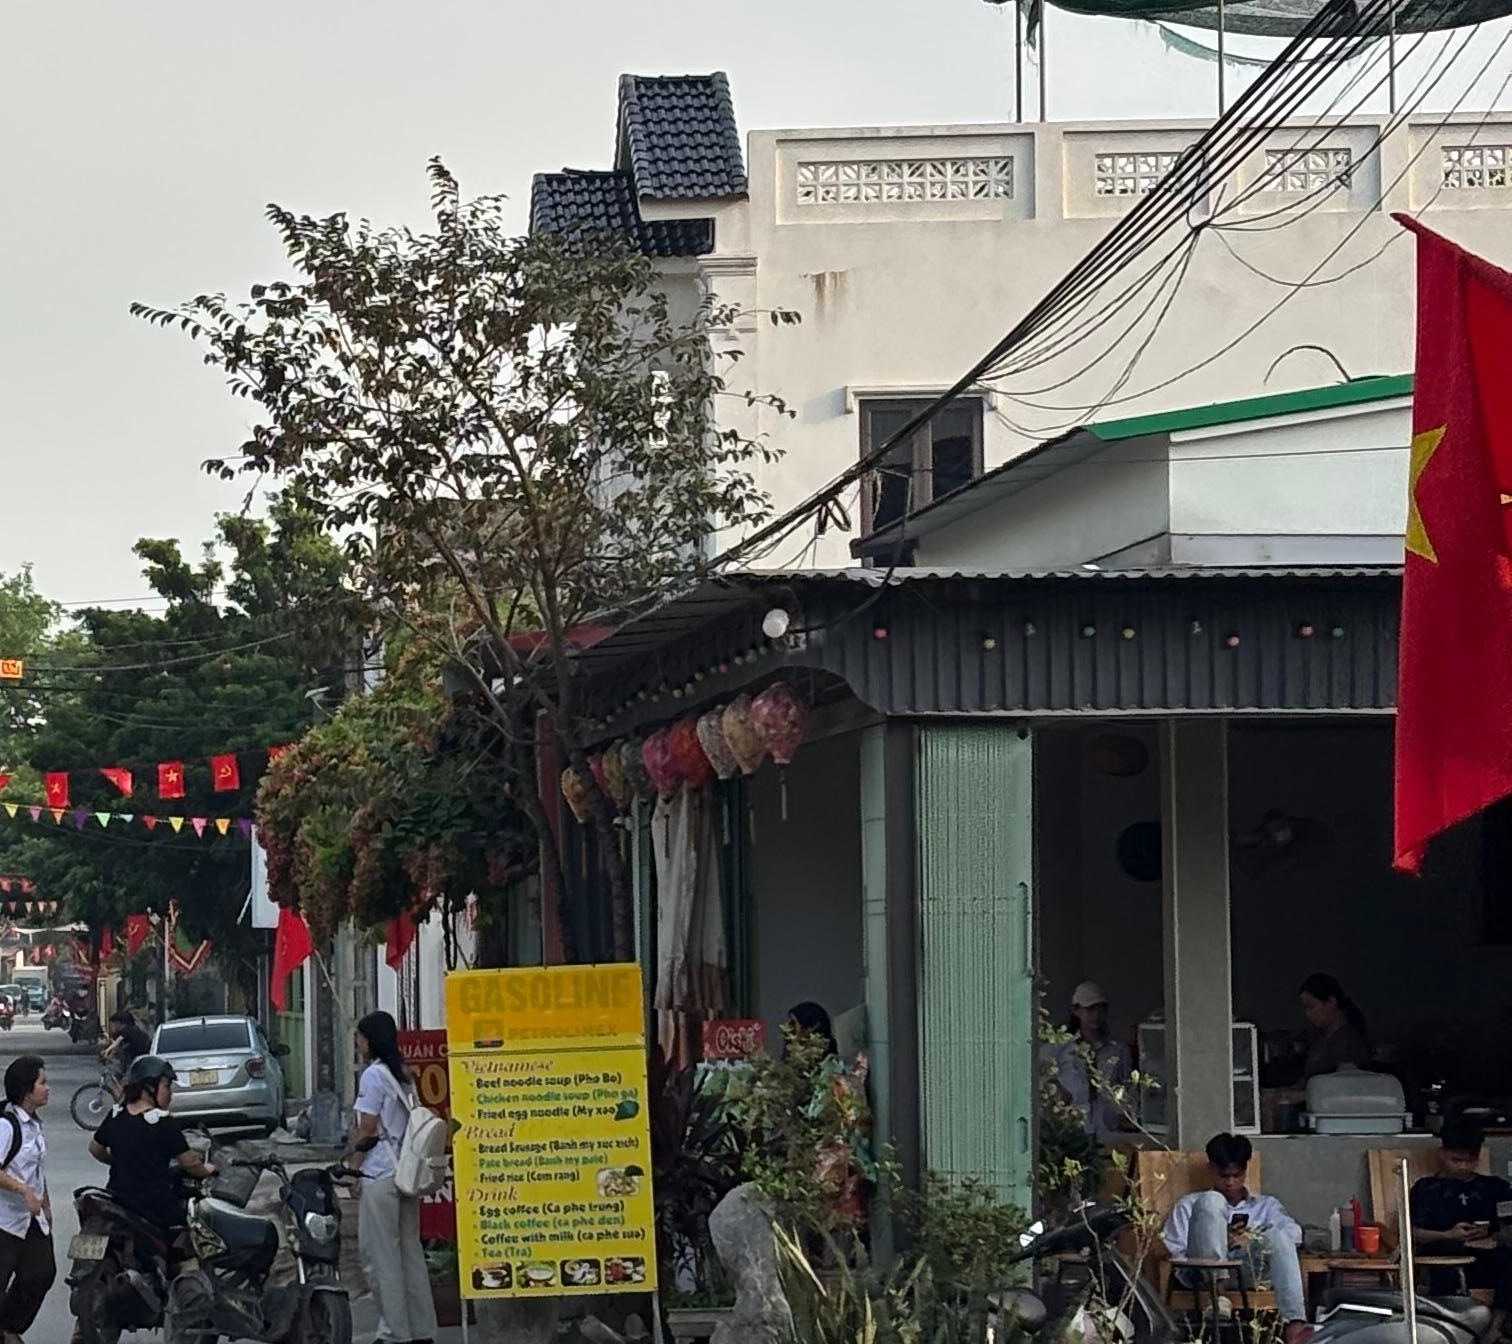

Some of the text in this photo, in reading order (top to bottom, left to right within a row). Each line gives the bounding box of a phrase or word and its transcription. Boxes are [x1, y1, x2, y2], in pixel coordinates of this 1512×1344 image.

[459, 970, 632, 1014] GASOLINE
[507, 1024, 619, 1041] PETROLIMEX
[476, 1072, 622, 1089] Beef noodle soup (Pho Bo)
[476, 1091, 519, 1105] Chicken
[521, 1089, 561, 1102] noodle
[563, 1089, 590, 1102] soup
[592, 1088, 619, 1102] (Pho
[477, 1108, 506, 1120] Fried
[508, 1109, 529, 1121] egg
[530, 1106, 570, 1119] noodle
[572, 1105, 594, 1118] (My
[465, 1122, 516, 1140] Bread
[478, 1142, 507, 1154] Bread
[502, 1154, 533, 1167] bread
[506, 1172, 525, 1182] rice
[554, 1169, 580, 1183] rang)
[467, 1185, 519, 1202] Drink
[479, 1199, 625, 1217] Egg coffee (Ca phe trung)
[480, 1218, 511, 1230] Black
[513, 1217, 550, 1229] coffee
[552, 1216, 570, 1229] (ca
[572, 1215, 595, 1228] phe
[480, 1233, 519, 1245] Coffee
[520, 1231, 547, 1243] with
[548, 1230, 575, 1241] milk
[577, 1229, 594, 1243] (ca
[481, 1246, 532, 1259] Tea (Tra)
